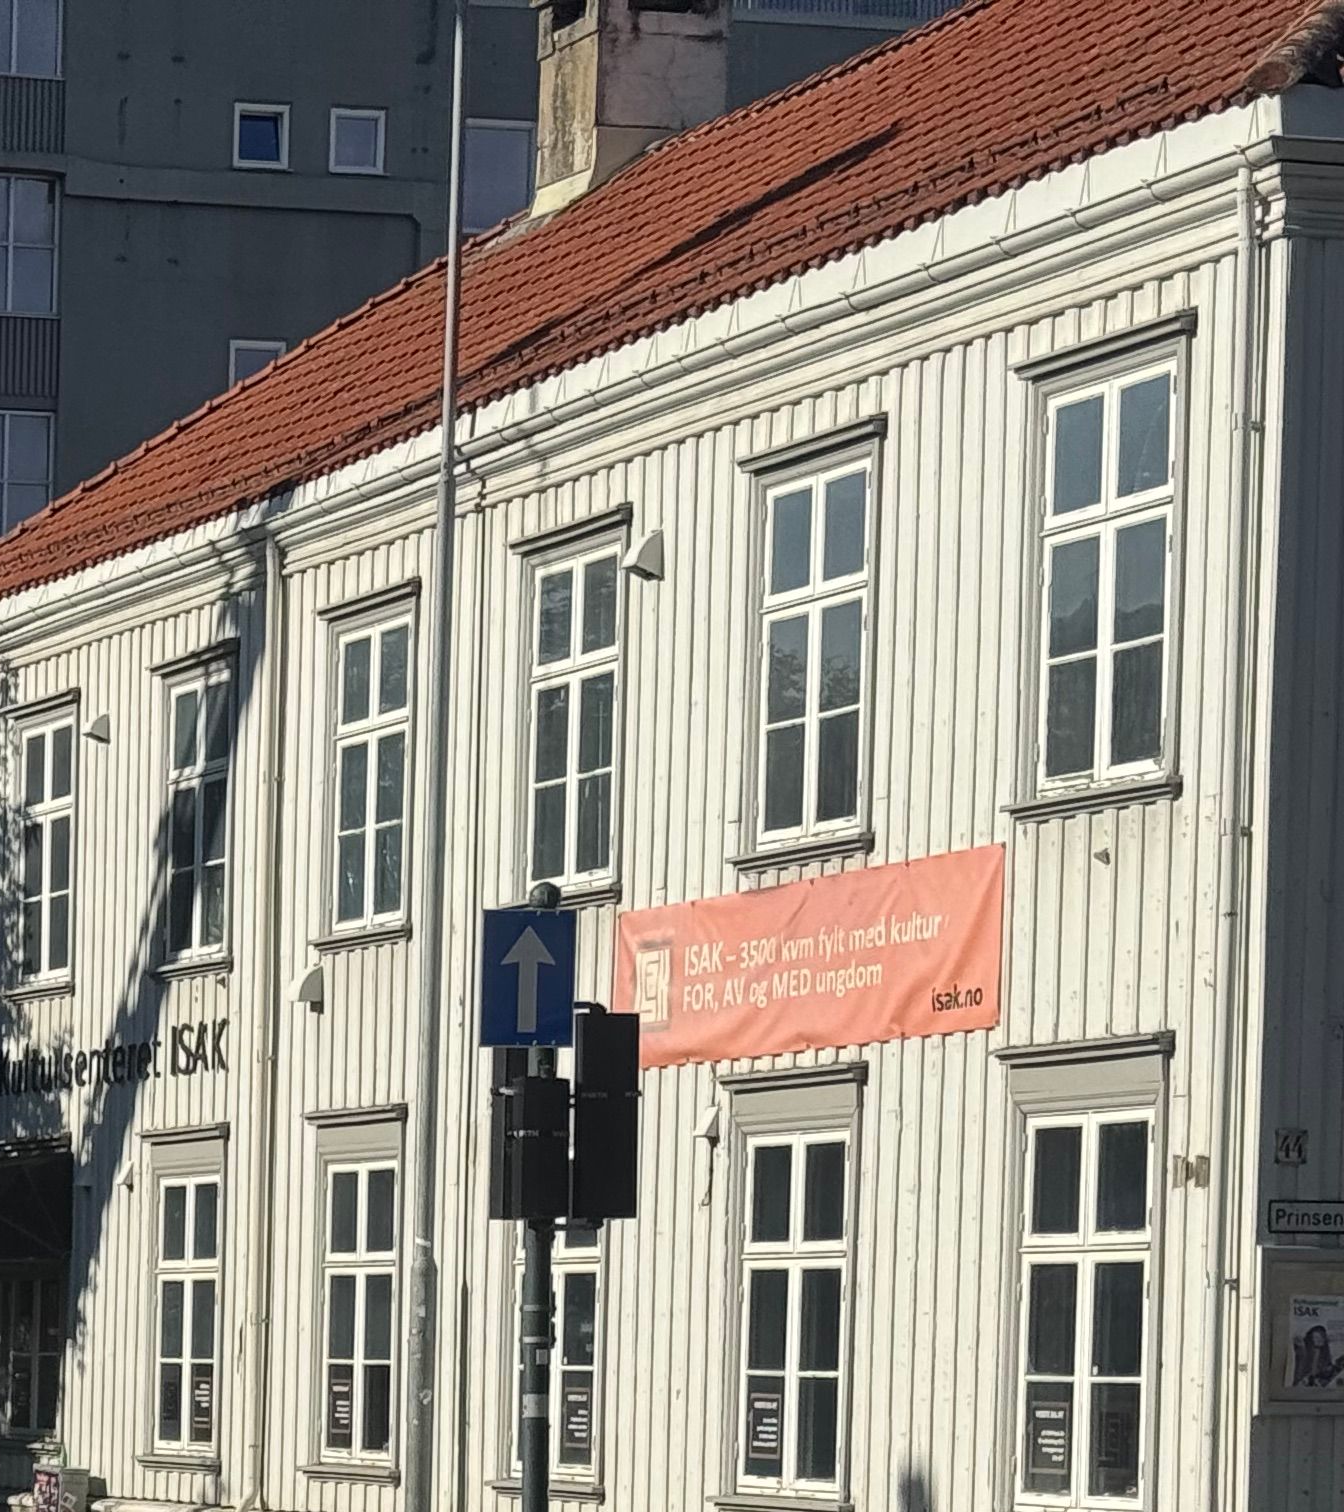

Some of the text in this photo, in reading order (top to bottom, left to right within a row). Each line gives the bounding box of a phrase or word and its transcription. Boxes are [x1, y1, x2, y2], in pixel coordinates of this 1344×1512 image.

[684, 941, 723, 977] ISAK
[739, 935, 776, 970] 3500
[781, 933, 814, 962] kvm
[818, 925, 845, 964] fylt
[849, 916, 886, 951] med
[890, 911, 942, 945] kultur
[682, 959, 883, 1013] FOR, AV og MED ungdom
[930, 983, 984, 1013] isak.no
[170, 1018, 230, 1077] ISAK
[1279, 1134, 1304, 1159] 44
[1275, 1208, 1344, 1227] Prinsen
